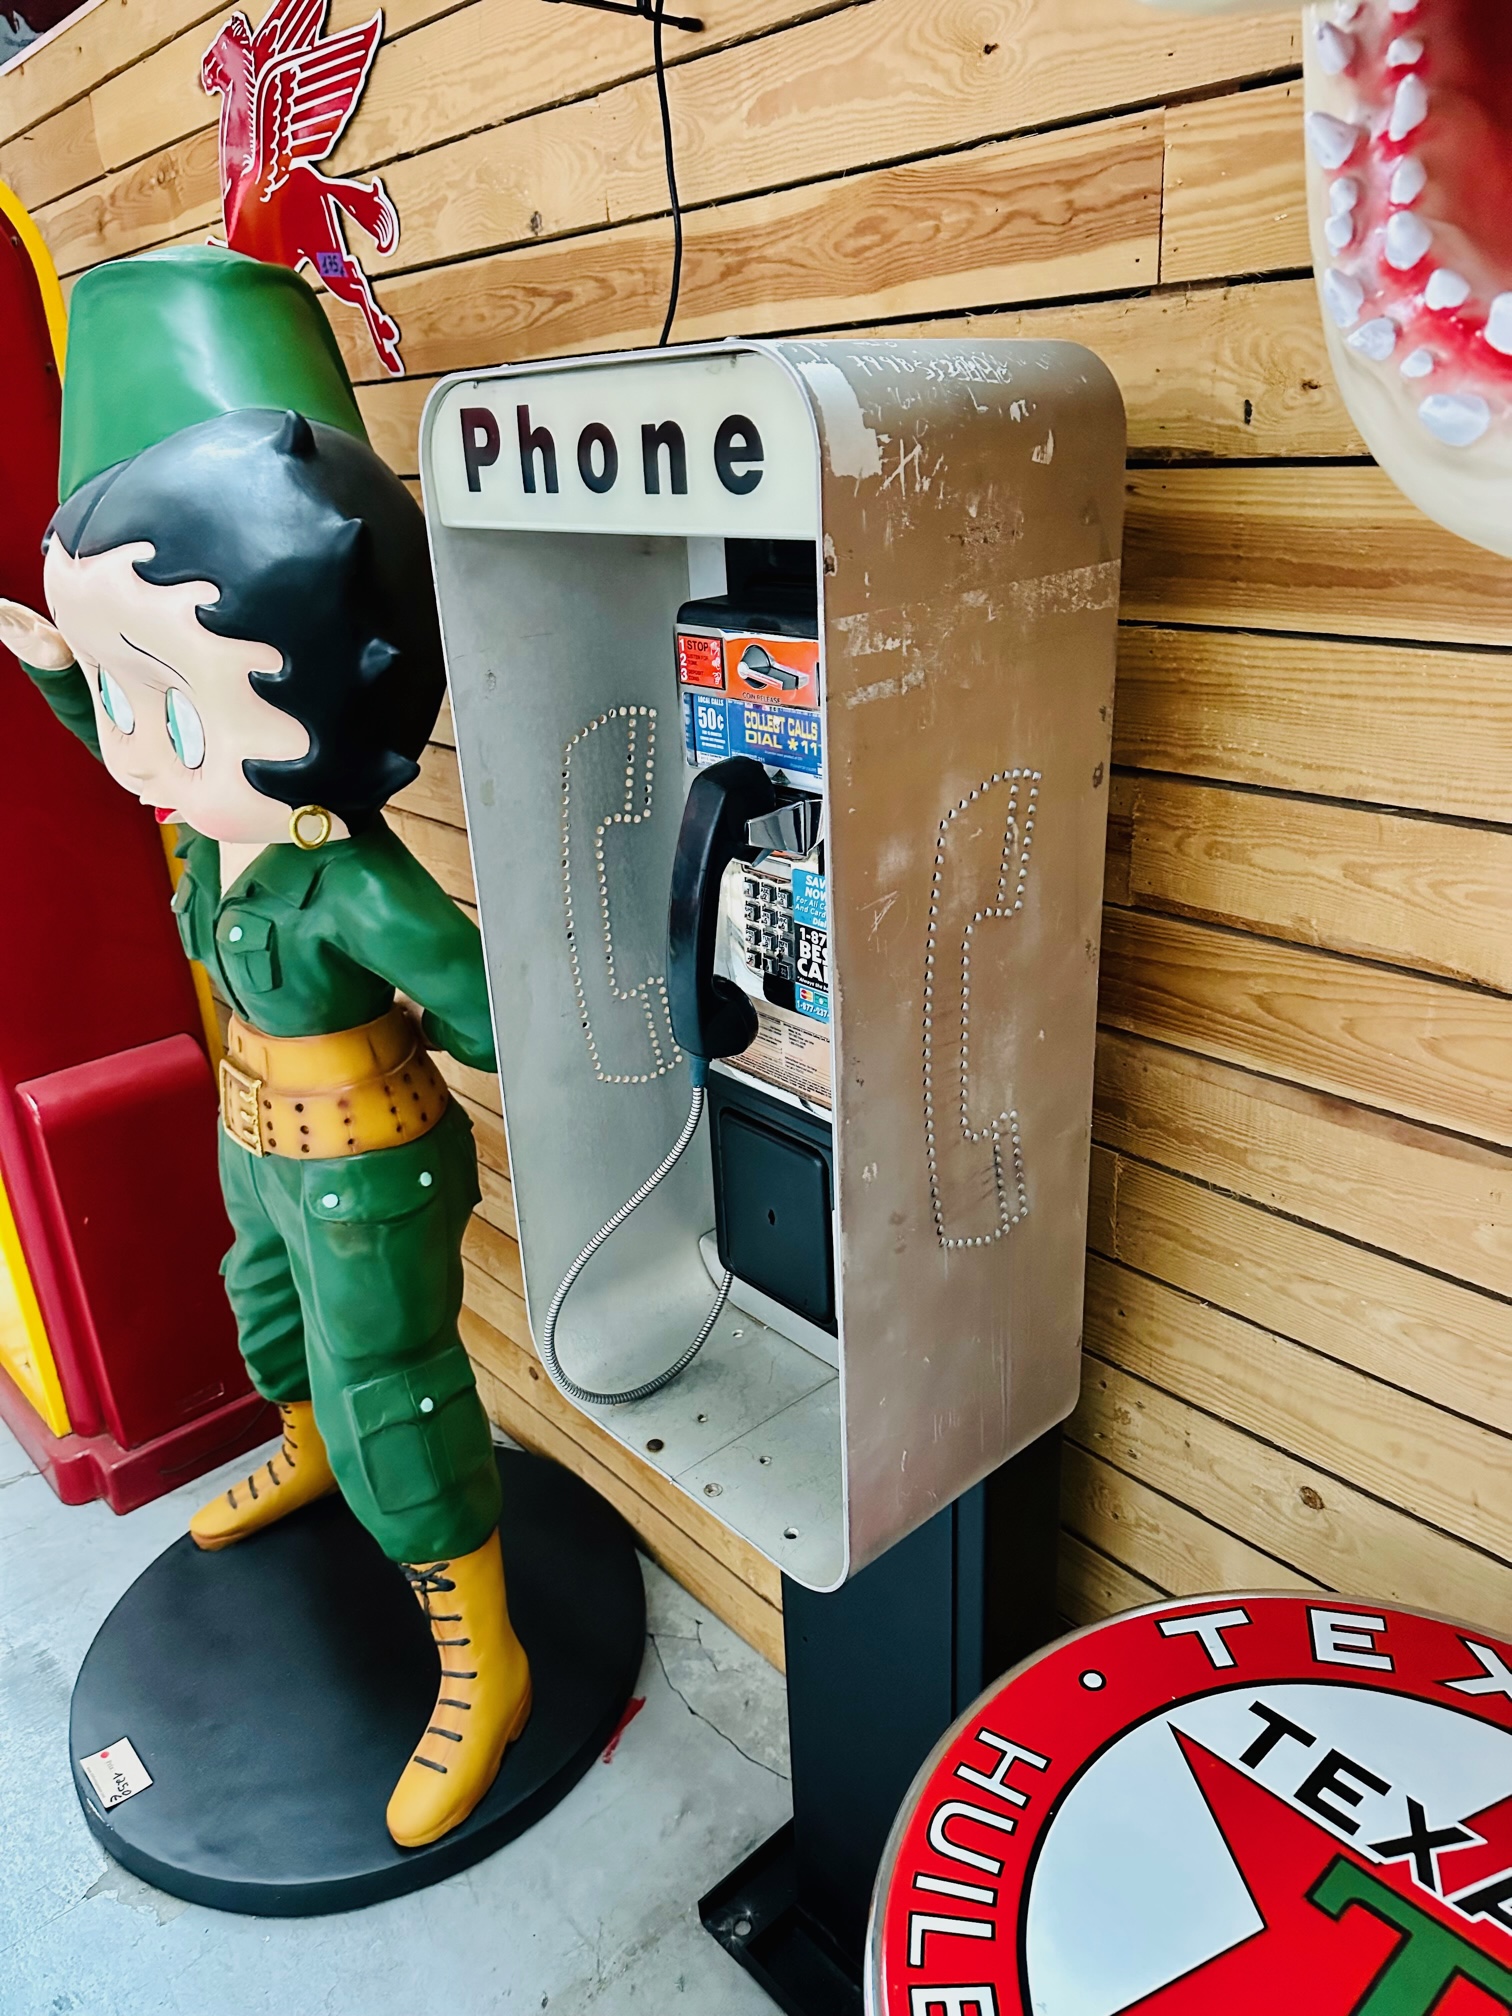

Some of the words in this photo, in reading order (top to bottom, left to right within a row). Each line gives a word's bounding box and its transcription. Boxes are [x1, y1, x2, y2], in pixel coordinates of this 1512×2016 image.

[460, 404, 765, 496] Phone
[679, 638, 685, 652] 1
[687, 640, 709, 652] STOP
[680, 652, 688, 667] 2
[681, 667, 688, 681] 3
[697, 695, 711, 704] LOCAL
[711, 697, 724, 706] CALLS
[742, 691, 756, 700] COIN
[756, 694, 781, 704] RELEASE
[697, 705, 725, 731] 50¢
[744, 710, 786, 735] COLLECT
[787, 717, 818, 741] CALLS
[745, 729, 784, 749] DIAL
[795, 903, 810, 913] And
[796, 895, 808, 905] For
[809, 900, 819, 908] All
[812, 917, 827, 929] Dial
[1155, 1606, 1512, 1700] TEX
[112, 1772, 132, 1796] 1250
[906, 1726, 1052, 2016] HUILE
